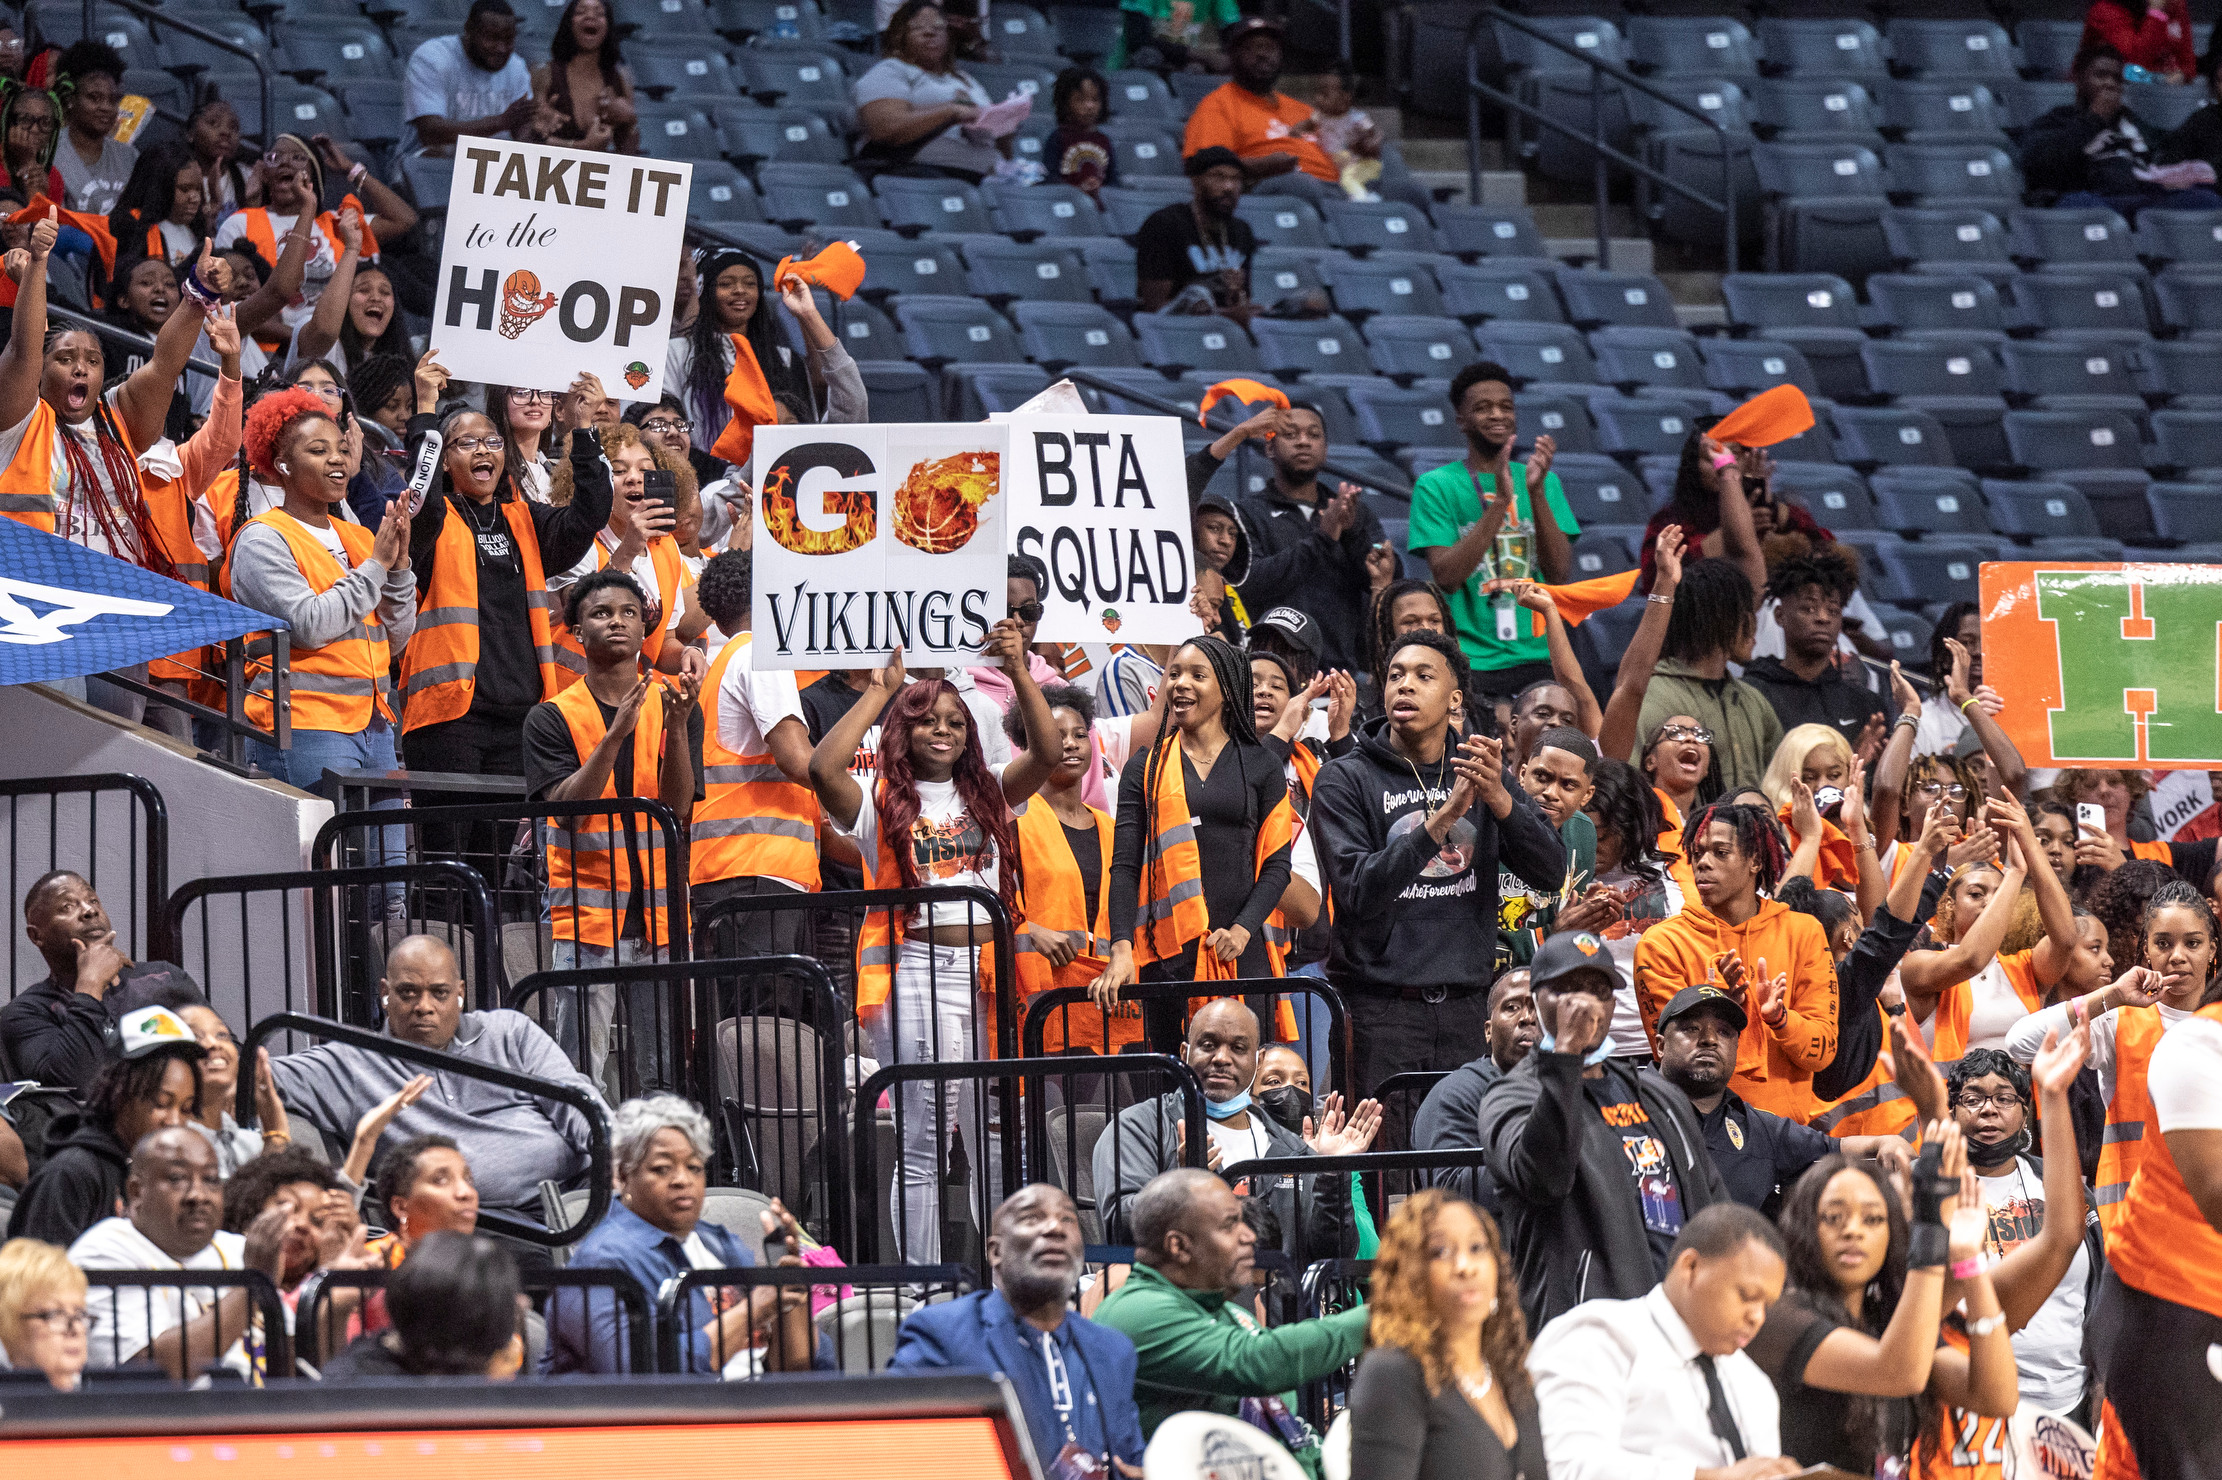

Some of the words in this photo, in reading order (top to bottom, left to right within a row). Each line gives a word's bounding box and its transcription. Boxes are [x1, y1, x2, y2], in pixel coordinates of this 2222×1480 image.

[466, 147, 611, 210] TAKE
[626, 167, 682, 217] IT
[465, 222, 500, 249] to
[506, 212, 558, 248] the
[418, 441, 438, 481] BILLION
[1032, 428, 1156, 509] BTA
[477, 532, 508, 544] BILLION
[1016, 525, 1188, 616] SQUAD
[765, 579, 992, 656] VIKINGS
[913, 825, 952, 839] TRUST
